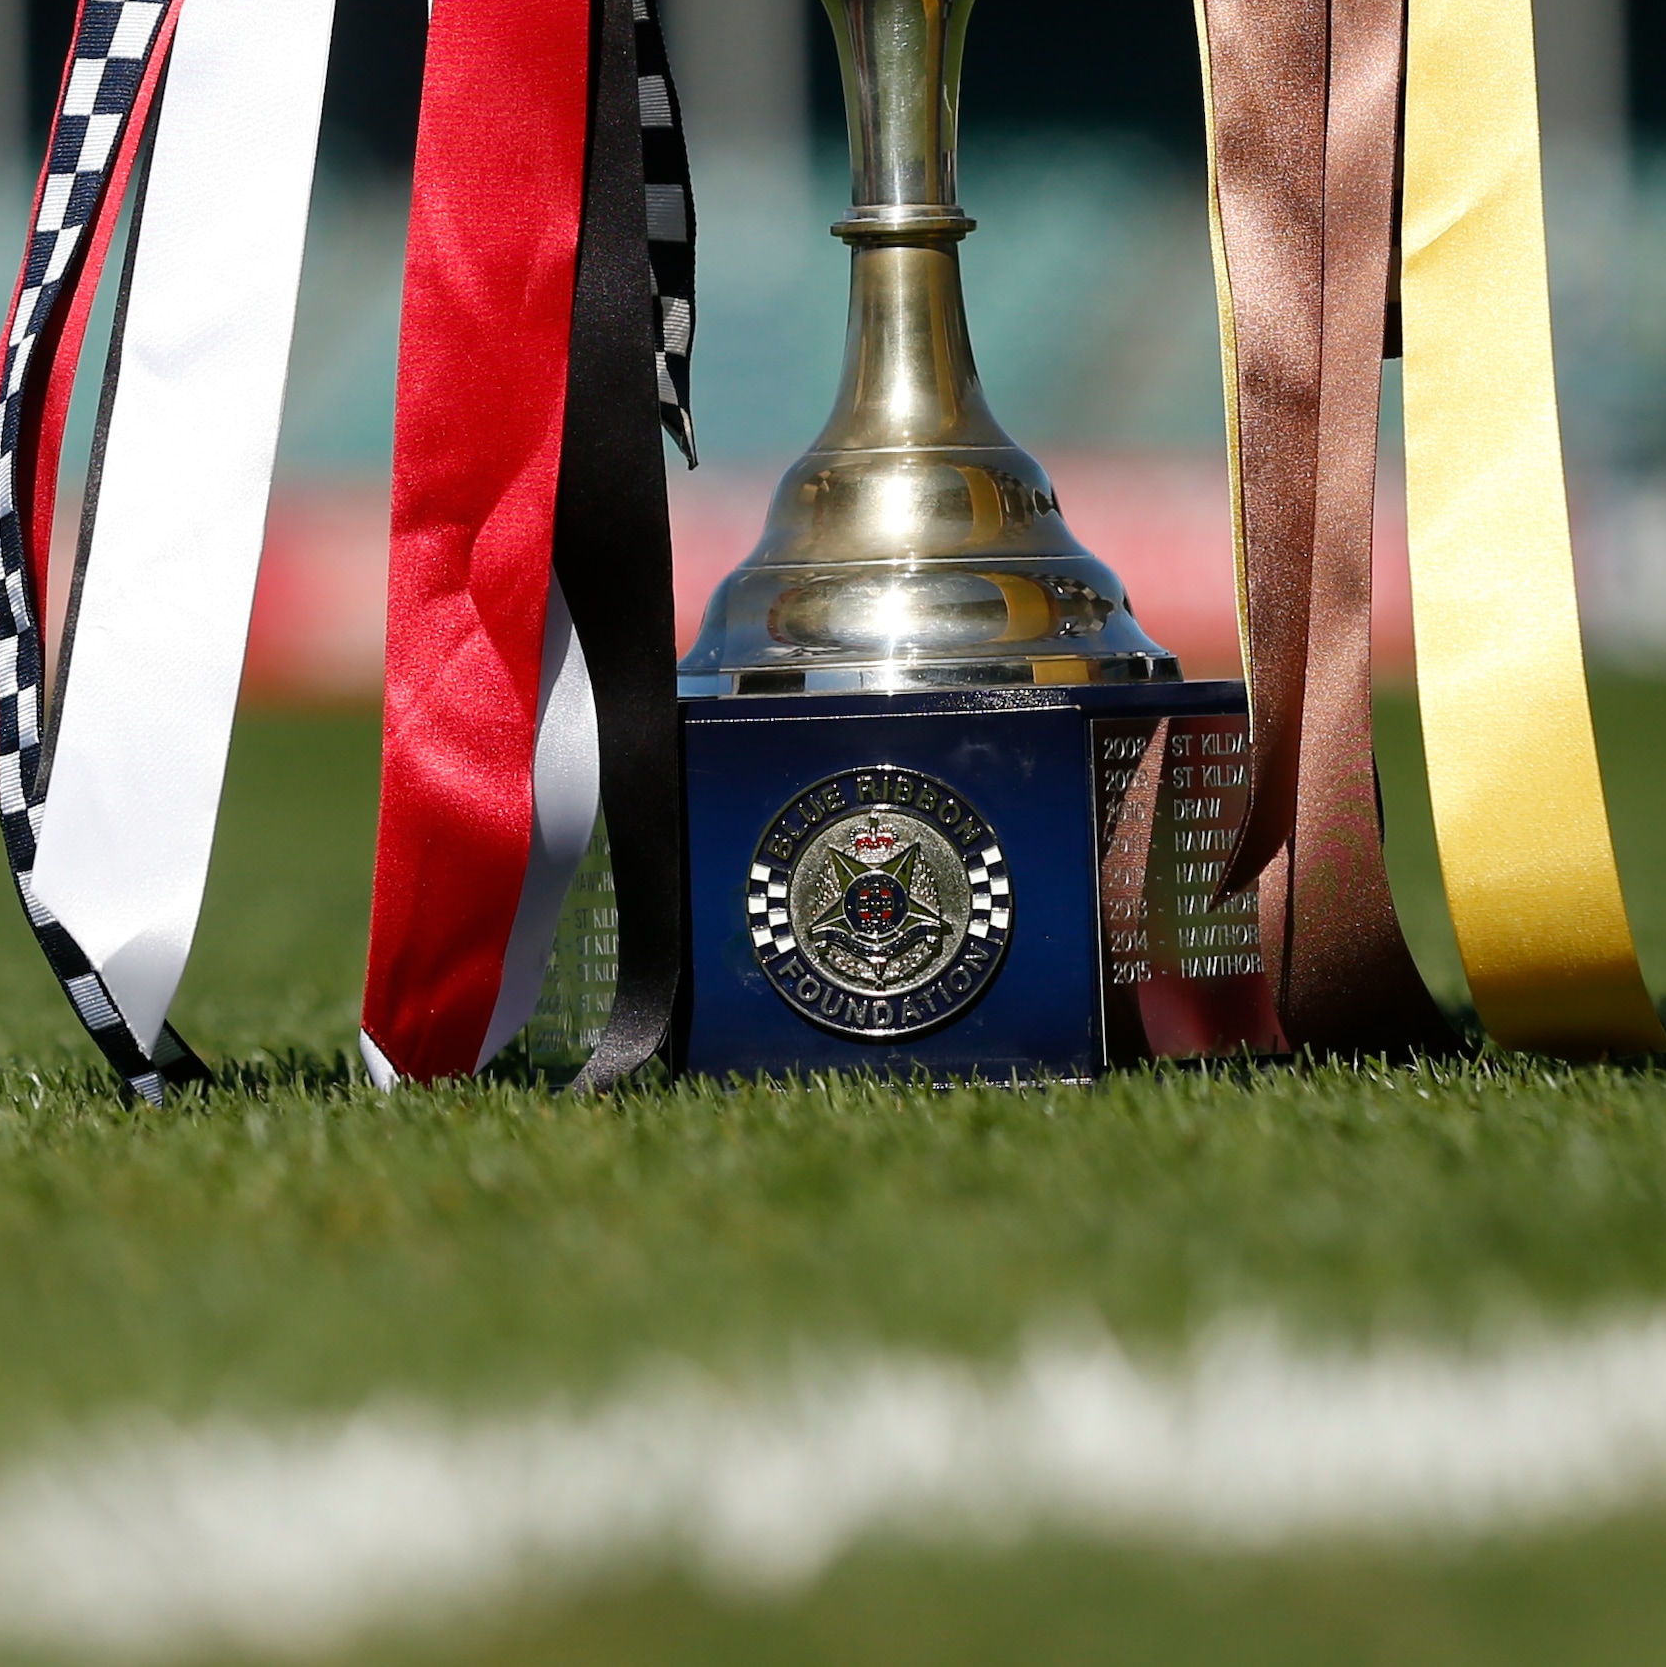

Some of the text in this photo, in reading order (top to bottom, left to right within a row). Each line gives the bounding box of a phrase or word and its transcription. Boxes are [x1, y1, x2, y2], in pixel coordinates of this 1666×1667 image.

[1104, 732, 1248, 760] 2008 ST KILDA
[1172, 766, 1194, 789] ST
[1201, 764, 1249, 788] KILDA
[767, 774, 984, 861] BLUE RIBBON
[1173, 797, 1221, 821] DRAW
[575, 908, 589, 929] ST
[593, 907, 619, 929] KILD
[576, 935, 590, 956] ST
[594, 933, 620, 956] KILD
[1110, 929, 1149, 953] 2014
[1178, 922, 1259, 948] HAWTHOR
[577, 963, 590, 983] ST
[595, 962, 619, 982] KILD
[1113, 959, 1153, 985] 2015
[1181, 952, 1265, 979] HAWTHOR
[777, 940, 991, 1028] FOUNDATION
